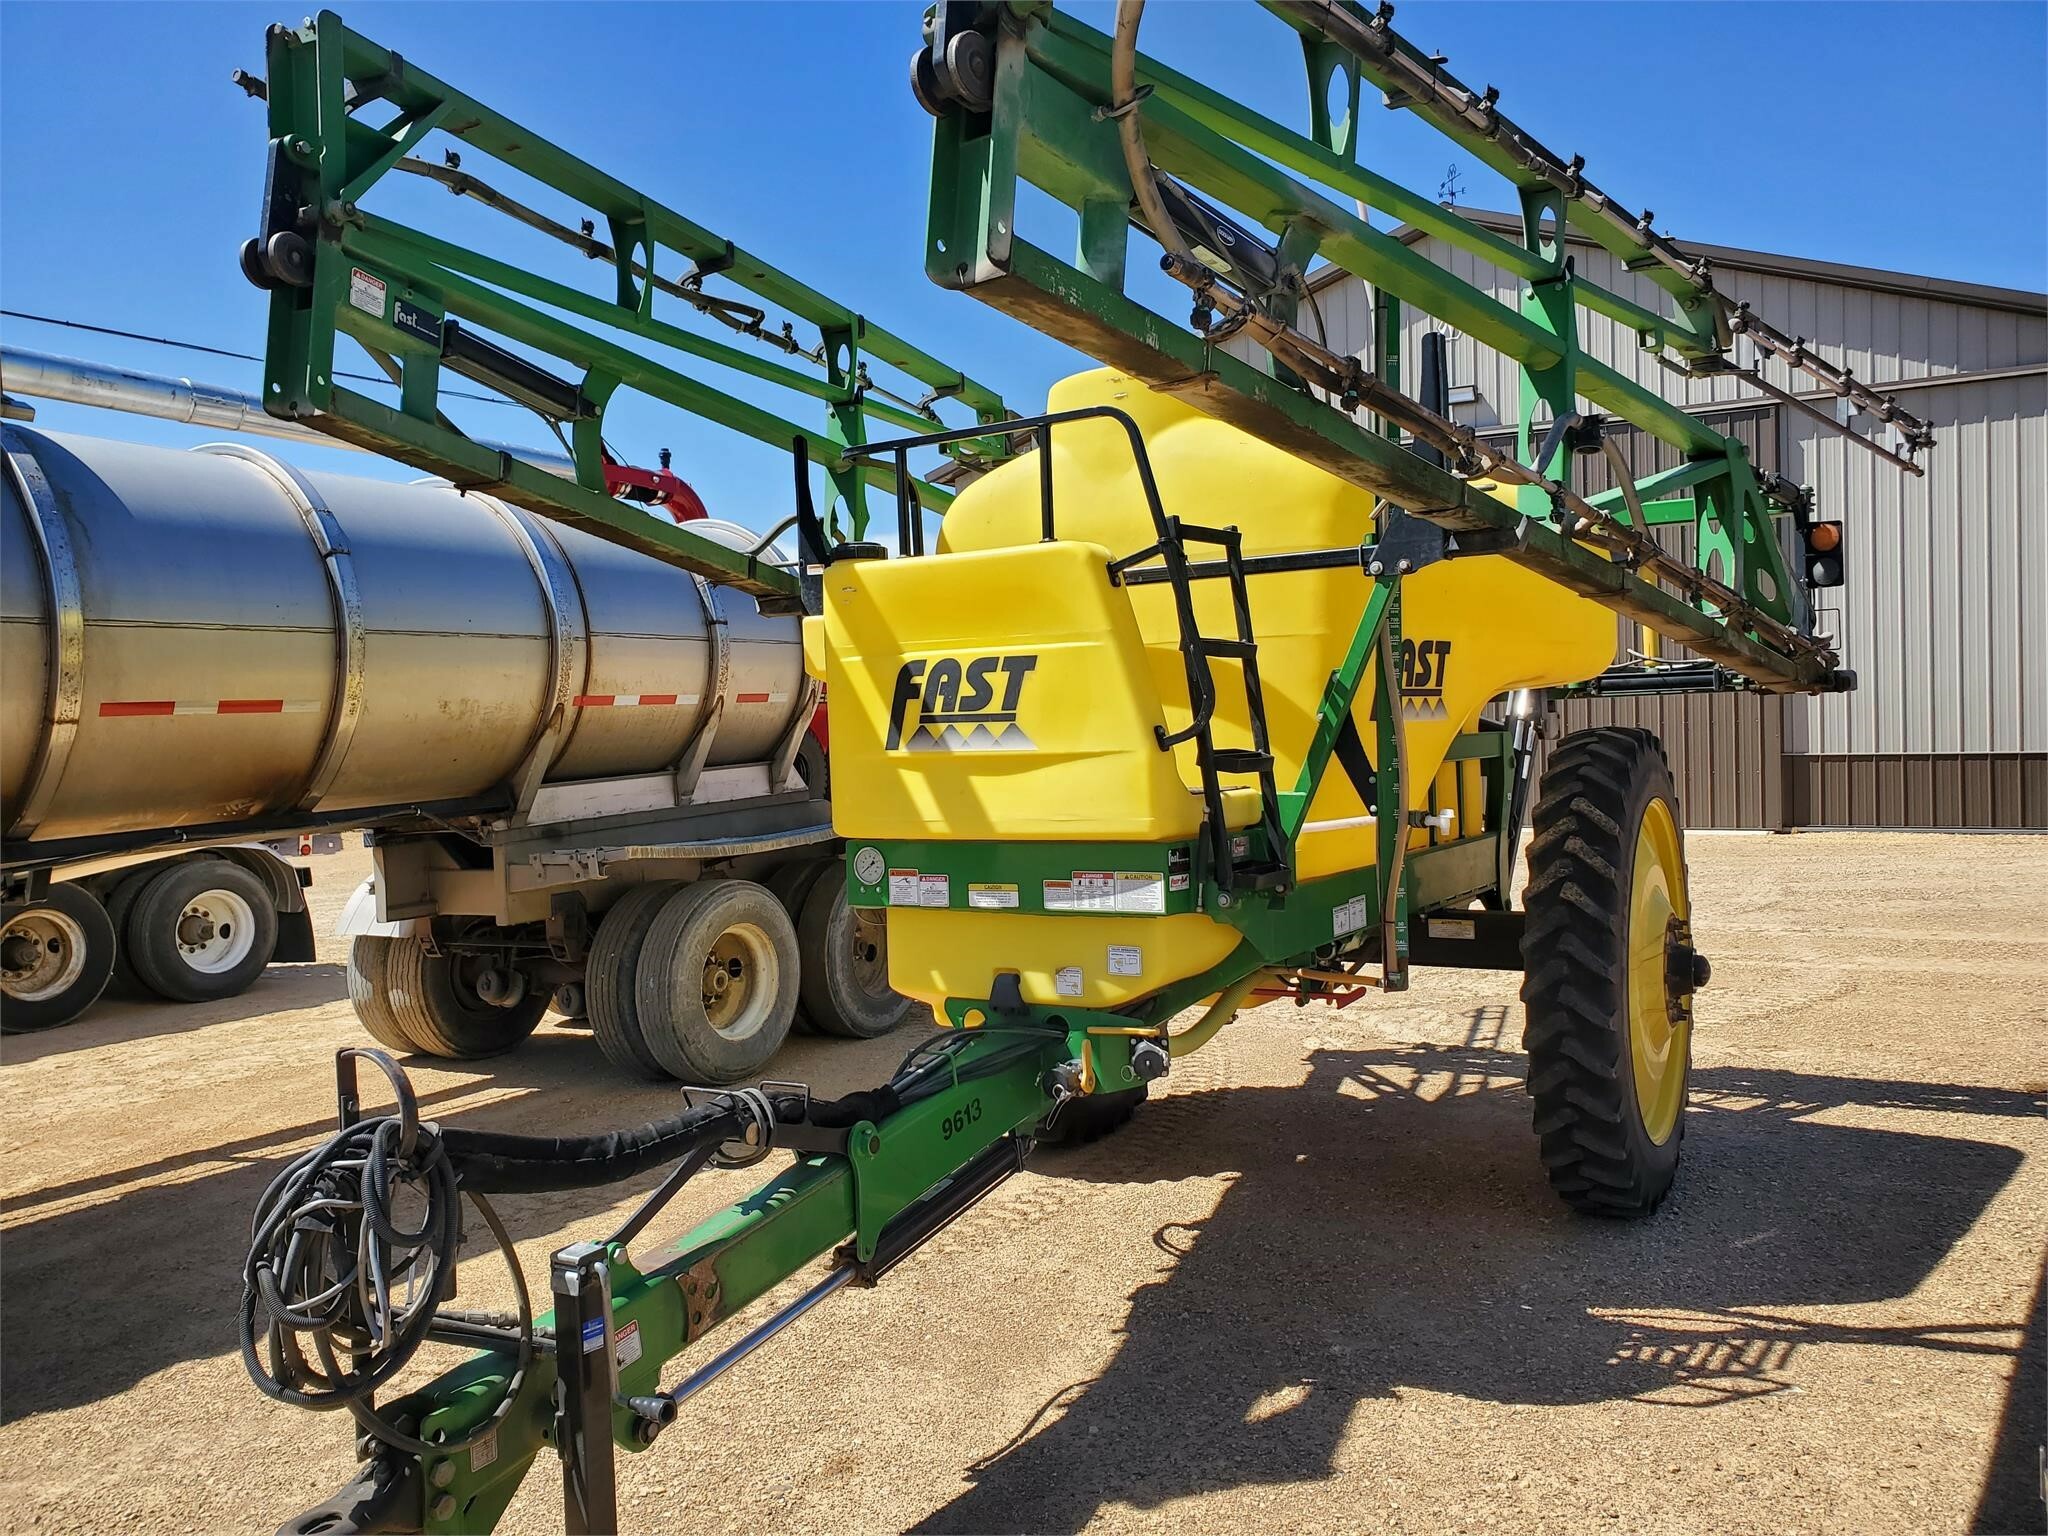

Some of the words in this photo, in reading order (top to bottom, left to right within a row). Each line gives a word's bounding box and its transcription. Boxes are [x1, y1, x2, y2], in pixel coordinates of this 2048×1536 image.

[360, 274, 384, 290] DANGER
[885, 655, 1038, 750] FAST
[941, 1098, 982, 1141] 9613
[614, 1324, 635, 1341] ANGER
